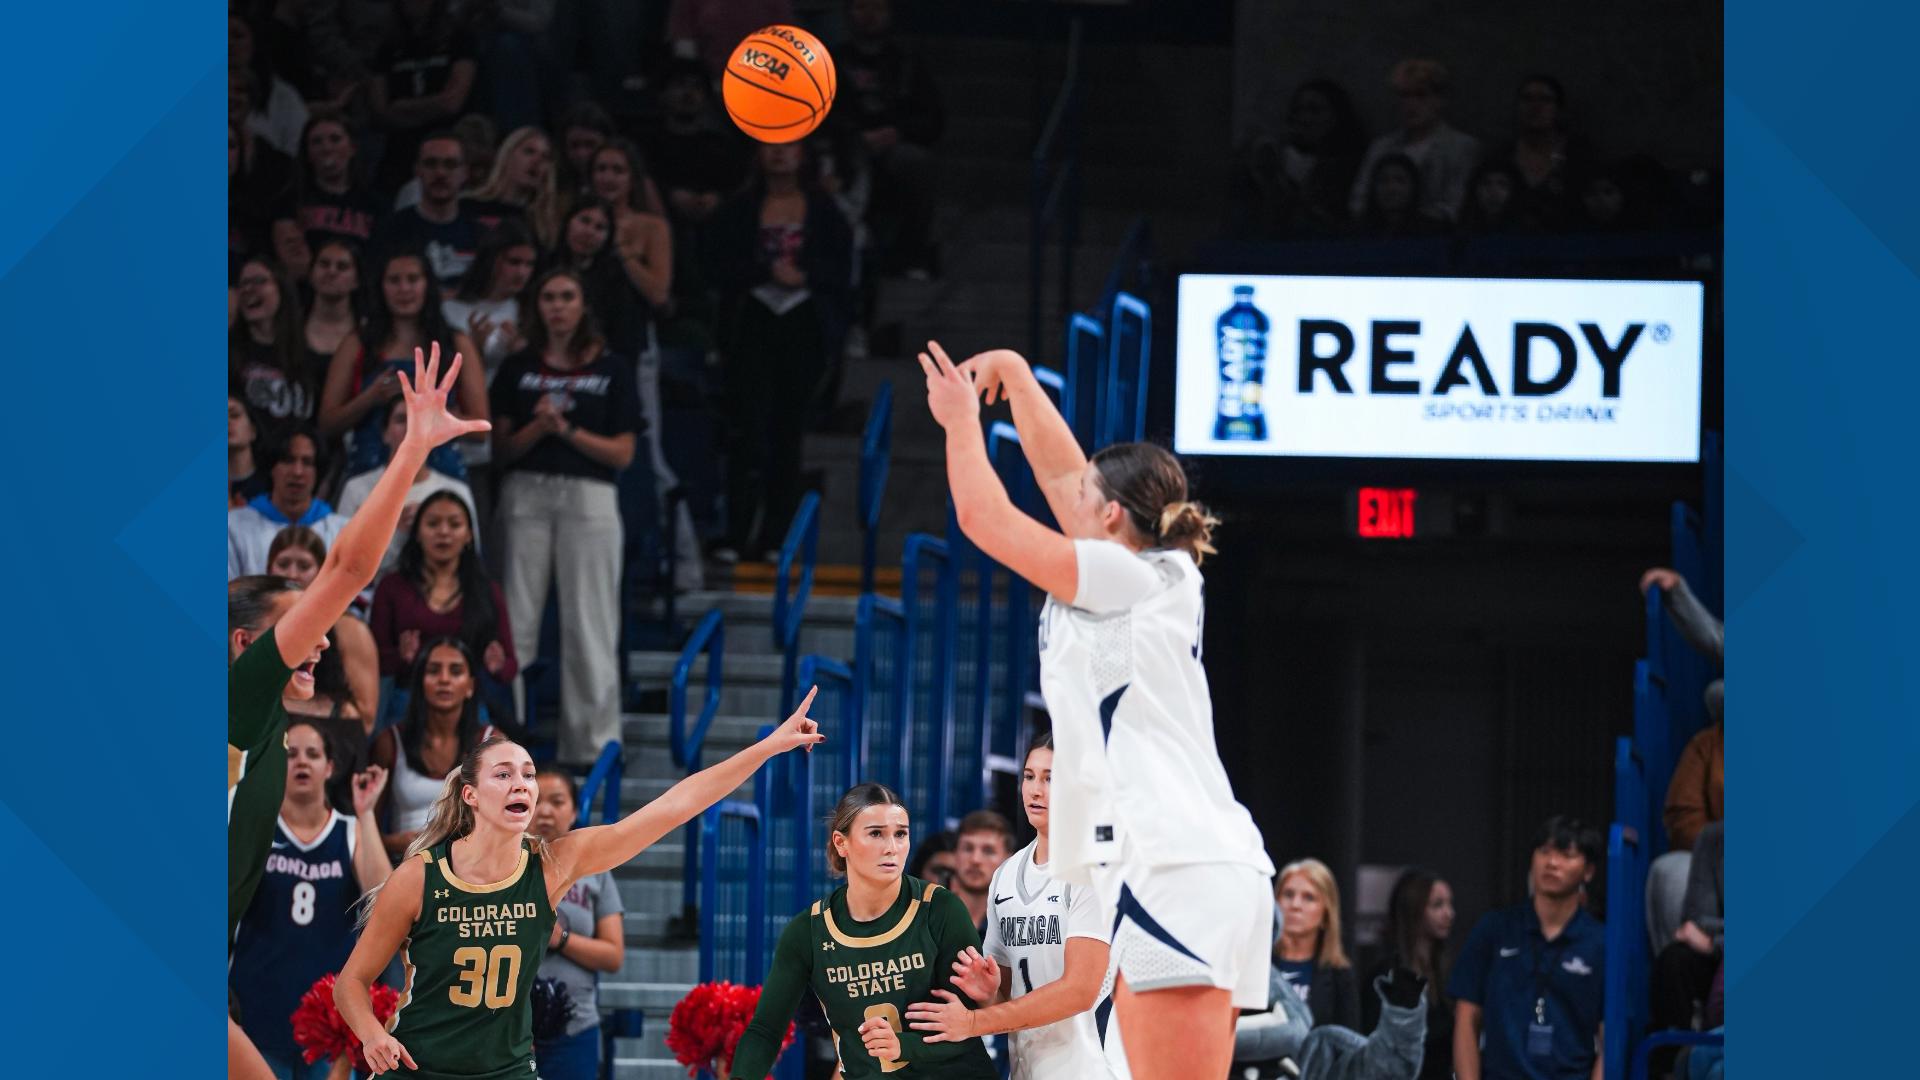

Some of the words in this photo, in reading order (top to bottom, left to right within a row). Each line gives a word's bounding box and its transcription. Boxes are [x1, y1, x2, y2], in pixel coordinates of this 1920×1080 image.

[743, 47, 790, 81] NCAA
[1297, 318, 1647, 398] READY
[1424, 401, 1528, 421] SPORTS
[1536, 403, 1617, 422] DRINK
[1359, 487, 1415, 538] EXIT
[266, 854, 343, 880] GONZAGA
[291, 881, 316, 926] 8
[437, 902, 537, 923] COLORADO
[459, 921, 517, 938] STATE
[448, 944, 522, 1009] 30
[826, 952, 926, 983] COLORADO
[1018, 957, 1033, 994] 1
[847, 973, 906, 998] STATE
